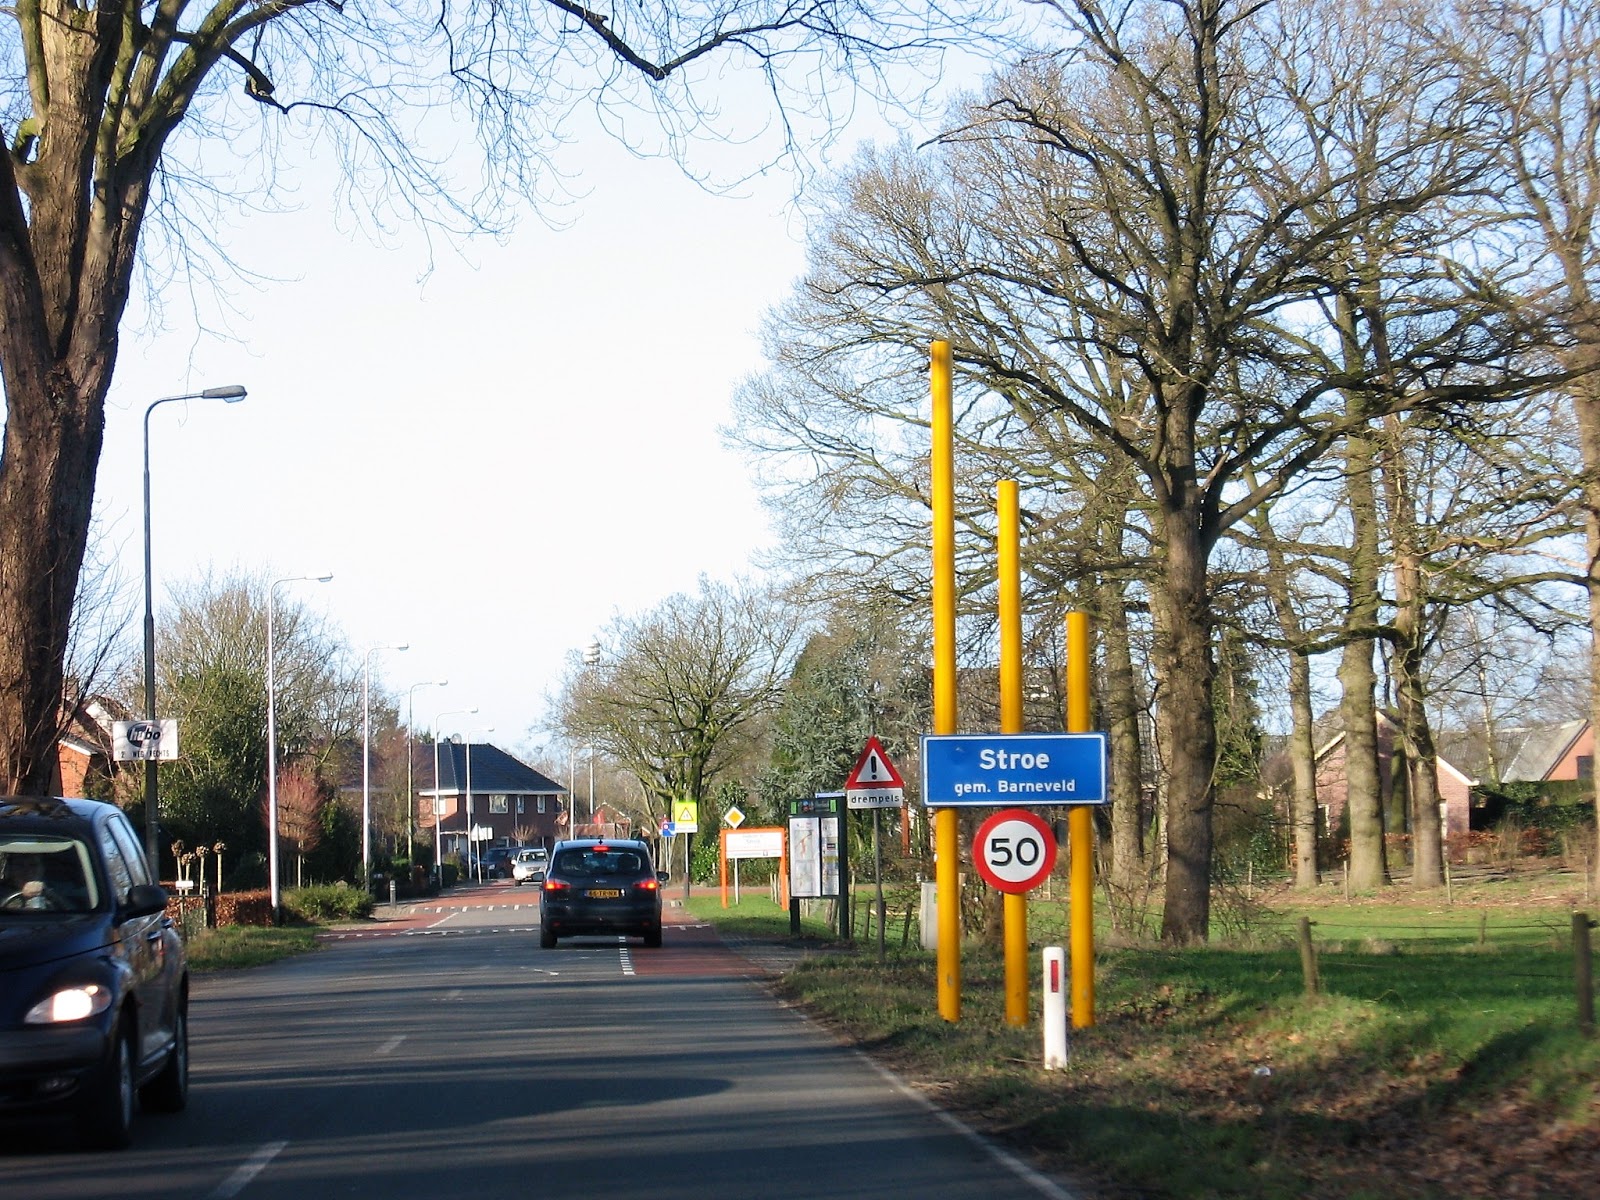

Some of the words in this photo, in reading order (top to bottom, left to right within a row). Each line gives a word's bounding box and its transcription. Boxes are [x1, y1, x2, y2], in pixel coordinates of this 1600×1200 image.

[979, 749, 1050, 770] Stroe
[954, 782, 991, 797] gem.
[998, 779, 1076, 793] Barneveld
[851, 794, 900, 804] drempels
[990, 837, 1040, 867] 50
